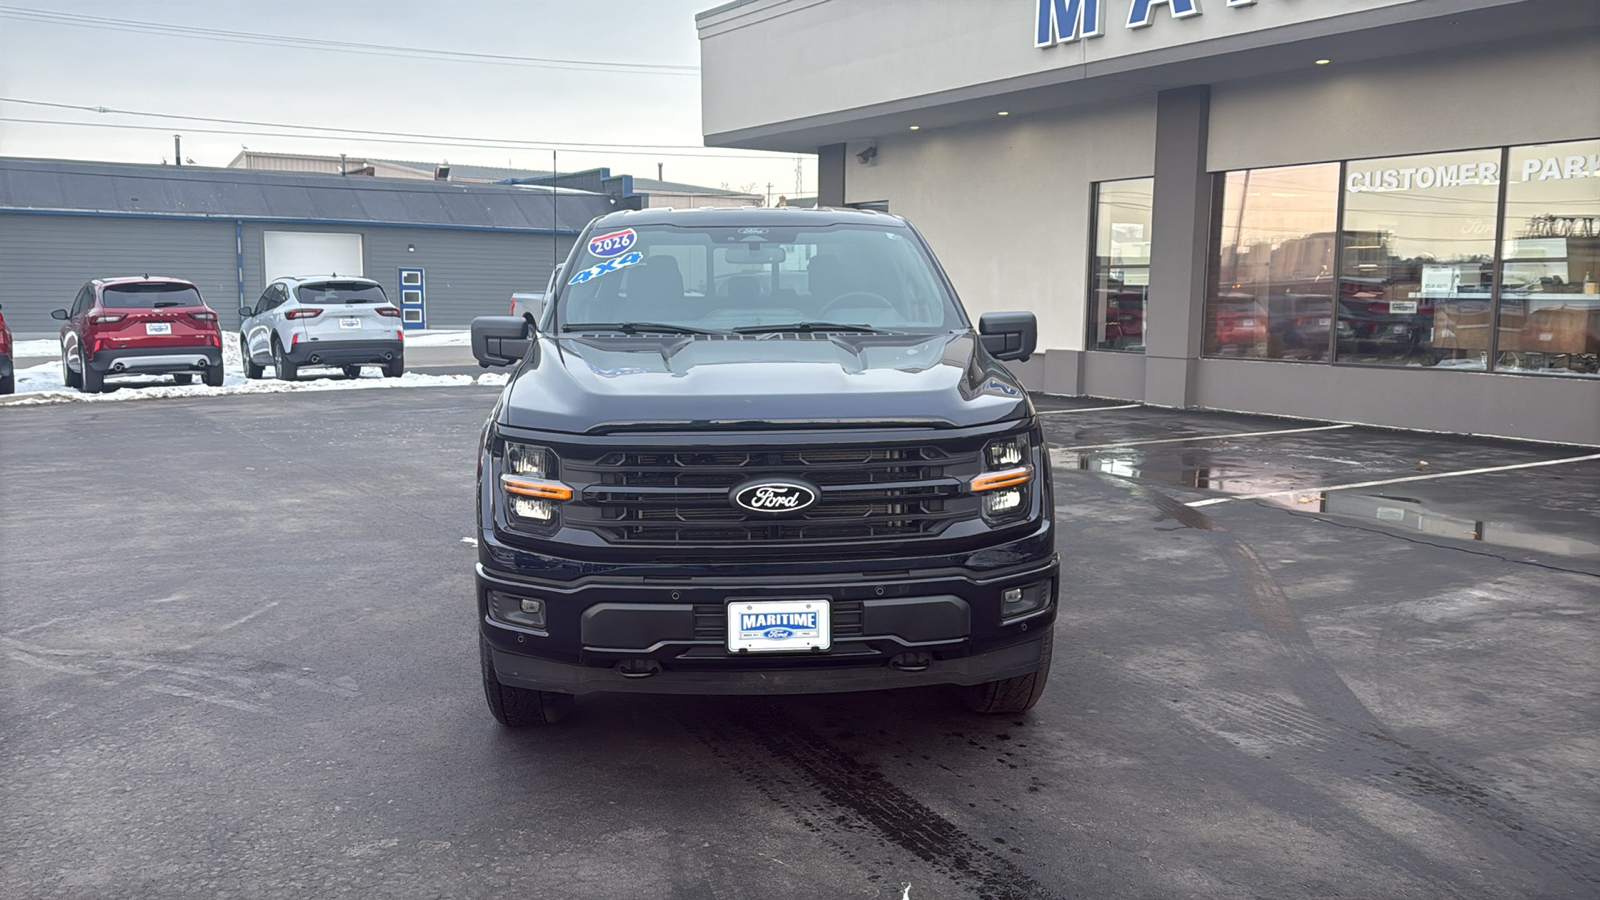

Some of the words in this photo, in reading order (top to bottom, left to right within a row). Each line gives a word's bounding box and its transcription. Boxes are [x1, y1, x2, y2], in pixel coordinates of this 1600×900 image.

[1347, 162, 1498, 193] CUSTOMER
[595, 234, 630, 253] 2026
[751, 487, 799, 507] Ford
[743, 613, 816, 630] MARITIME
[767, 630, 789, 638] Ford
